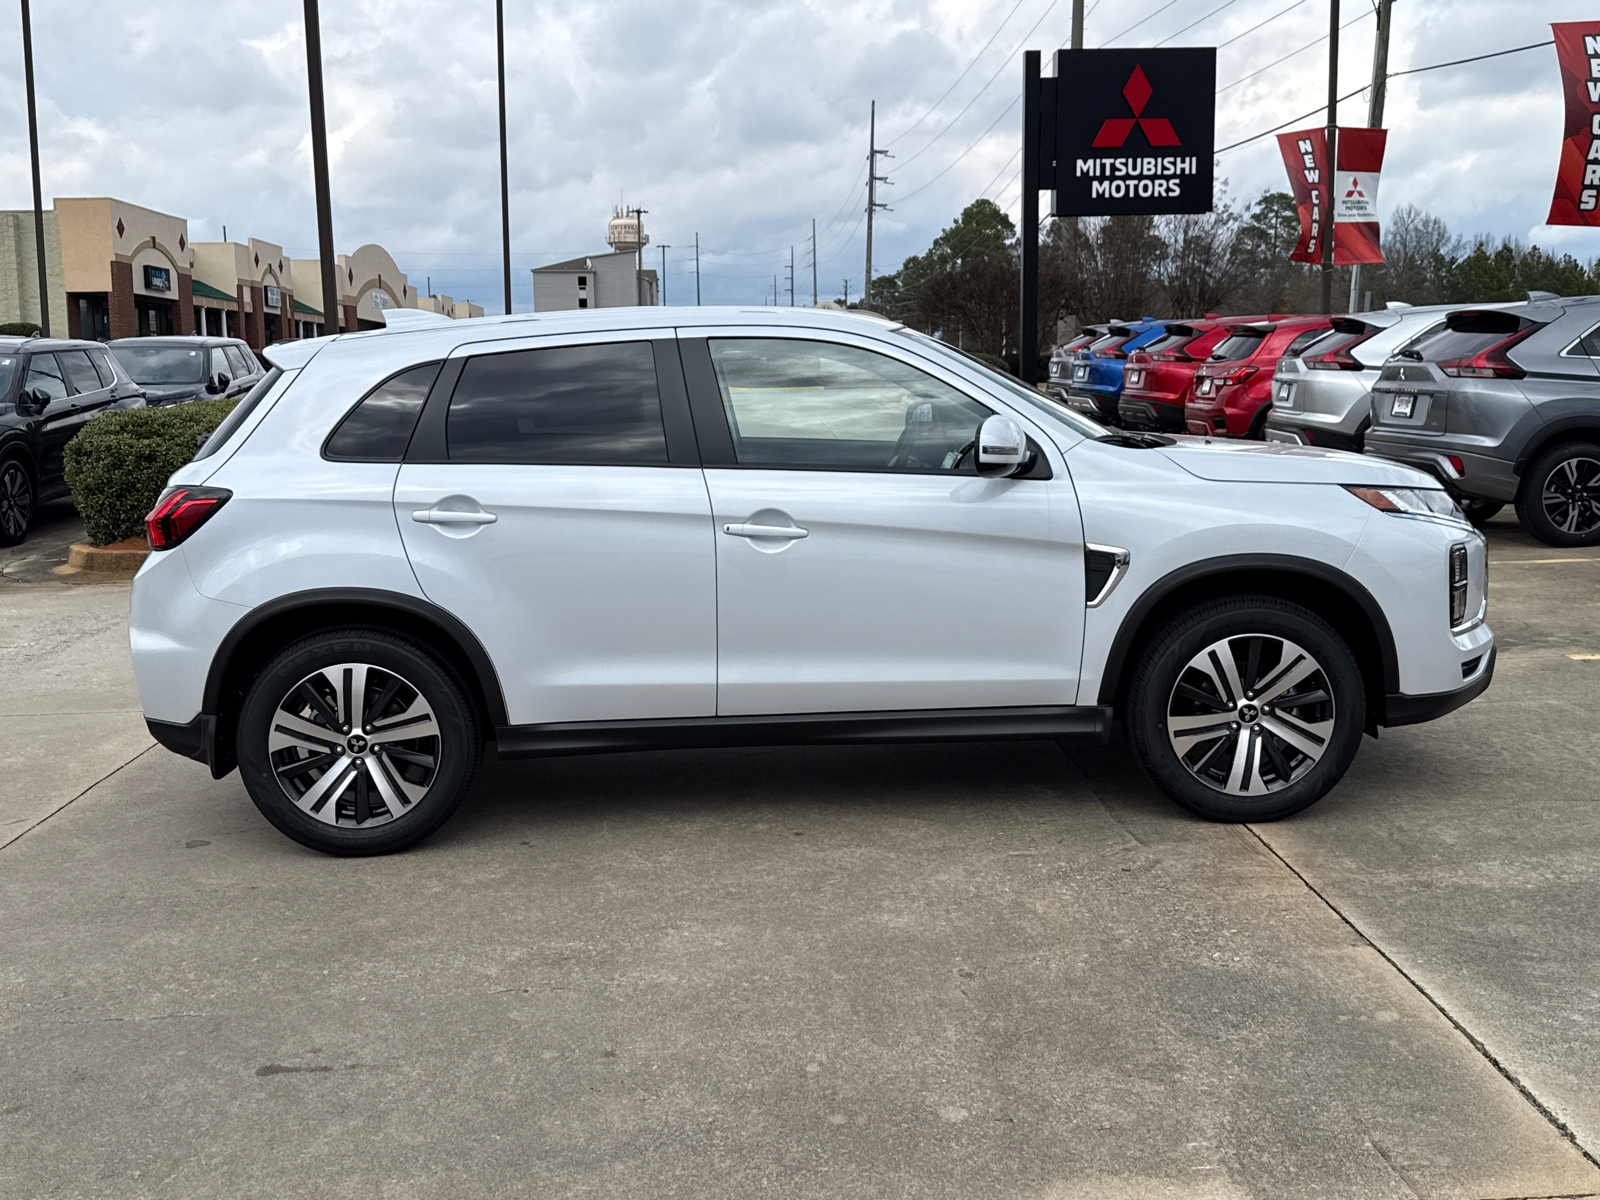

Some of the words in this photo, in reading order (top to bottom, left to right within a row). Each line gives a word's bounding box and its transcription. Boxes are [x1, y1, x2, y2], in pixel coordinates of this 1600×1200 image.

[1075, 156, 1197, 177] MITSUBISHI
[1297, 139, 1320, 184] NEW
[1091, 178, 1181, 199] MOTORS
[1306, 189, 1320, 253] CARS
[279, 642, 371, 677] NEXEN
